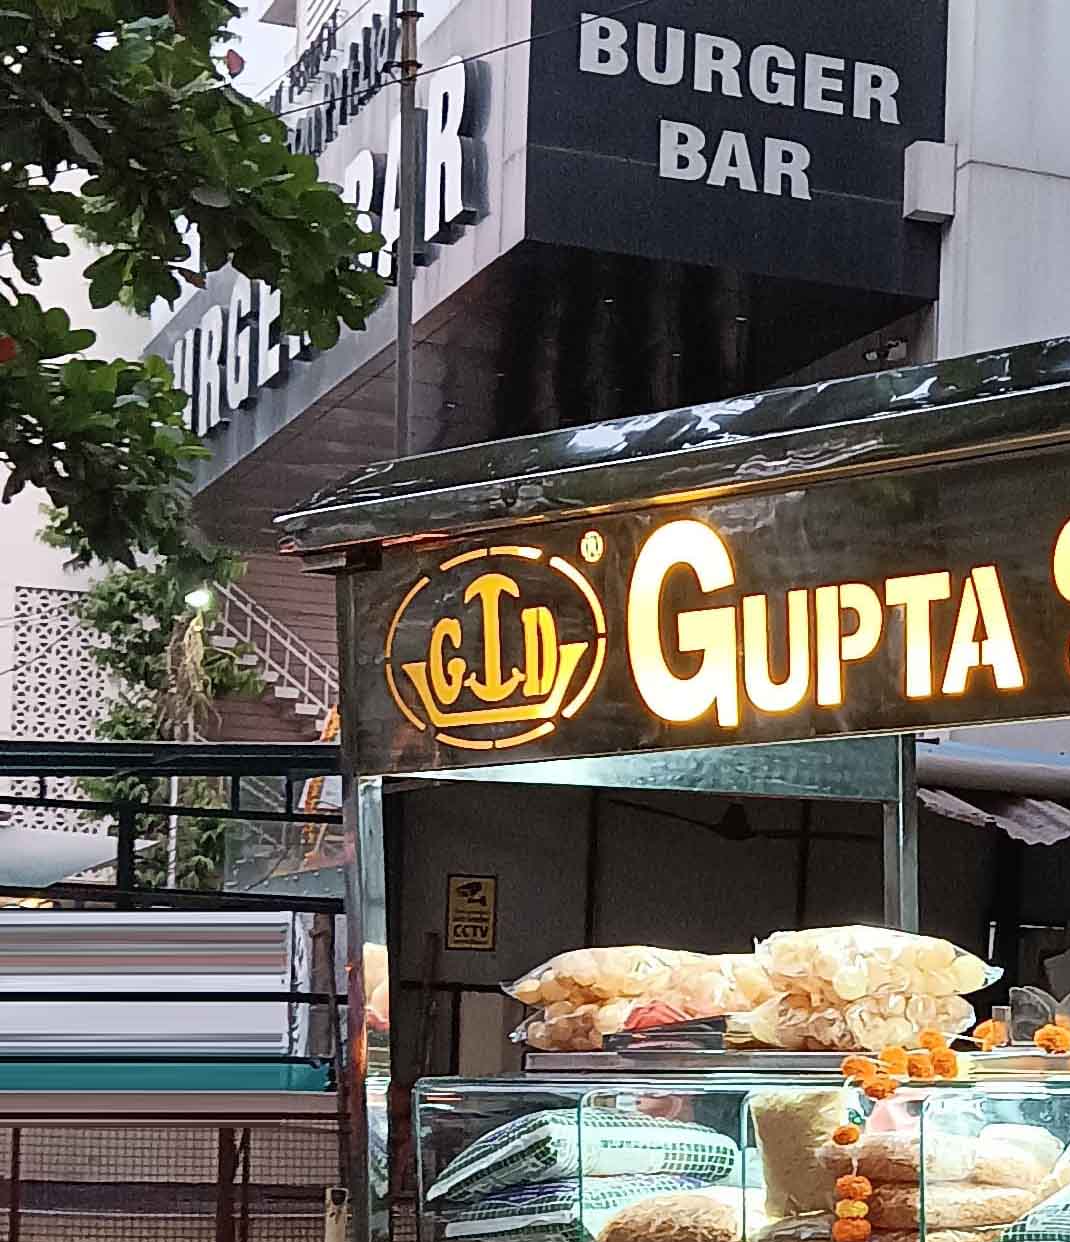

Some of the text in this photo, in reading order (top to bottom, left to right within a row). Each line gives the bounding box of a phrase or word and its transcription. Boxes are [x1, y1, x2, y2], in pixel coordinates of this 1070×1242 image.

[580, 12, 900, 124] BURGER
[659, 119, 812, 200] BAR
[627, 518, 1024, 728] GUPTA
[453, 924, 489, 938] CCTV
